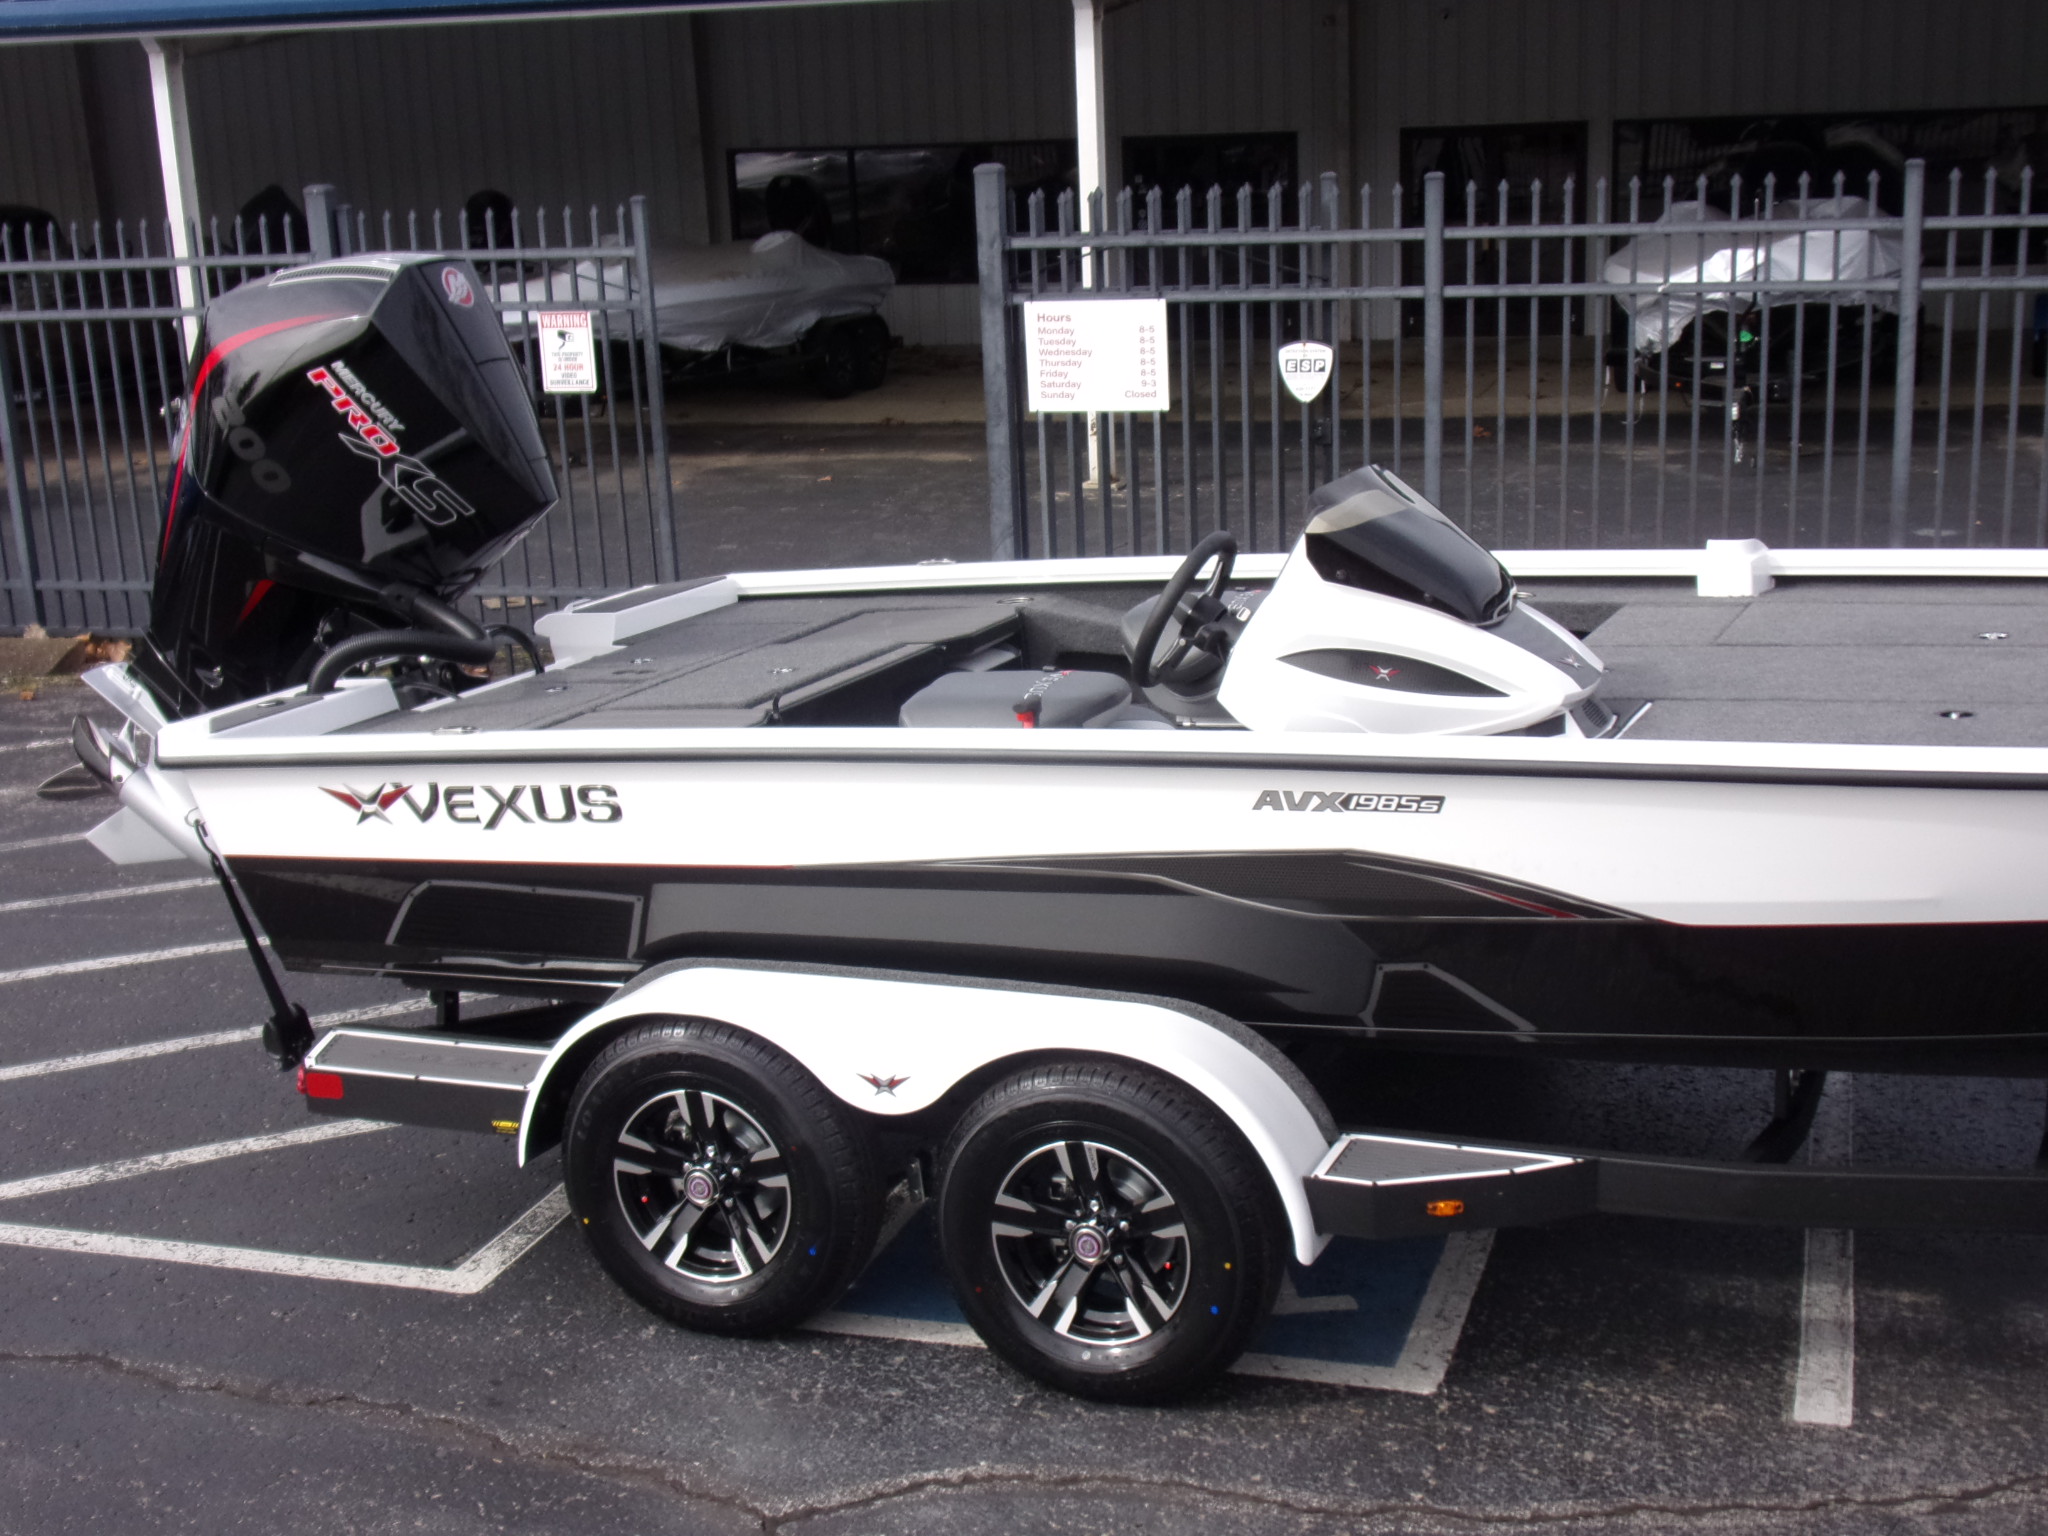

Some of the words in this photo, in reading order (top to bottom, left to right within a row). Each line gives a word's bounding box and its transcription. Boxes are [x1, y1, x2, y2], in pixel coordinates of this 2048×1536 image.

[541, 313, 587, 328] WARNING
[1036, 313, 1072, 323] Hours
[1038, 327, 1075, 336] Monday
[1139, 325, 1155, 334] 8-5
[1038, 338, 1077, 347] Tuesday
[1139, 336, 1155, 344] 8-5
[1038, 348, 1093, 358] Wednesday
[1139, 347, 1156, 355] 8-5
[553, 363, 562, 371] 24
[564, 363, 584, 371] HOUR
[1039, 359, 1082, 369] Thursday
[1140, 358, 1156, 366] 8-5
[1286, 359, 1326, 372] ESP
[1039, 370, 1069, 379] Friday
[1040, 380, 1081, 389] Saturday
[1141, 379, 1157, 387] 9-3
[330, 360, 405, 431] MERCURY
[1040, 391, 1075, 400] Sunday
[1124, 390, 1157, 398] Closed
[307, 366, 400, 456] PRO
[390, 782, 623, 830] VEXUS
[1252, 790, 1346, 812] AVX
